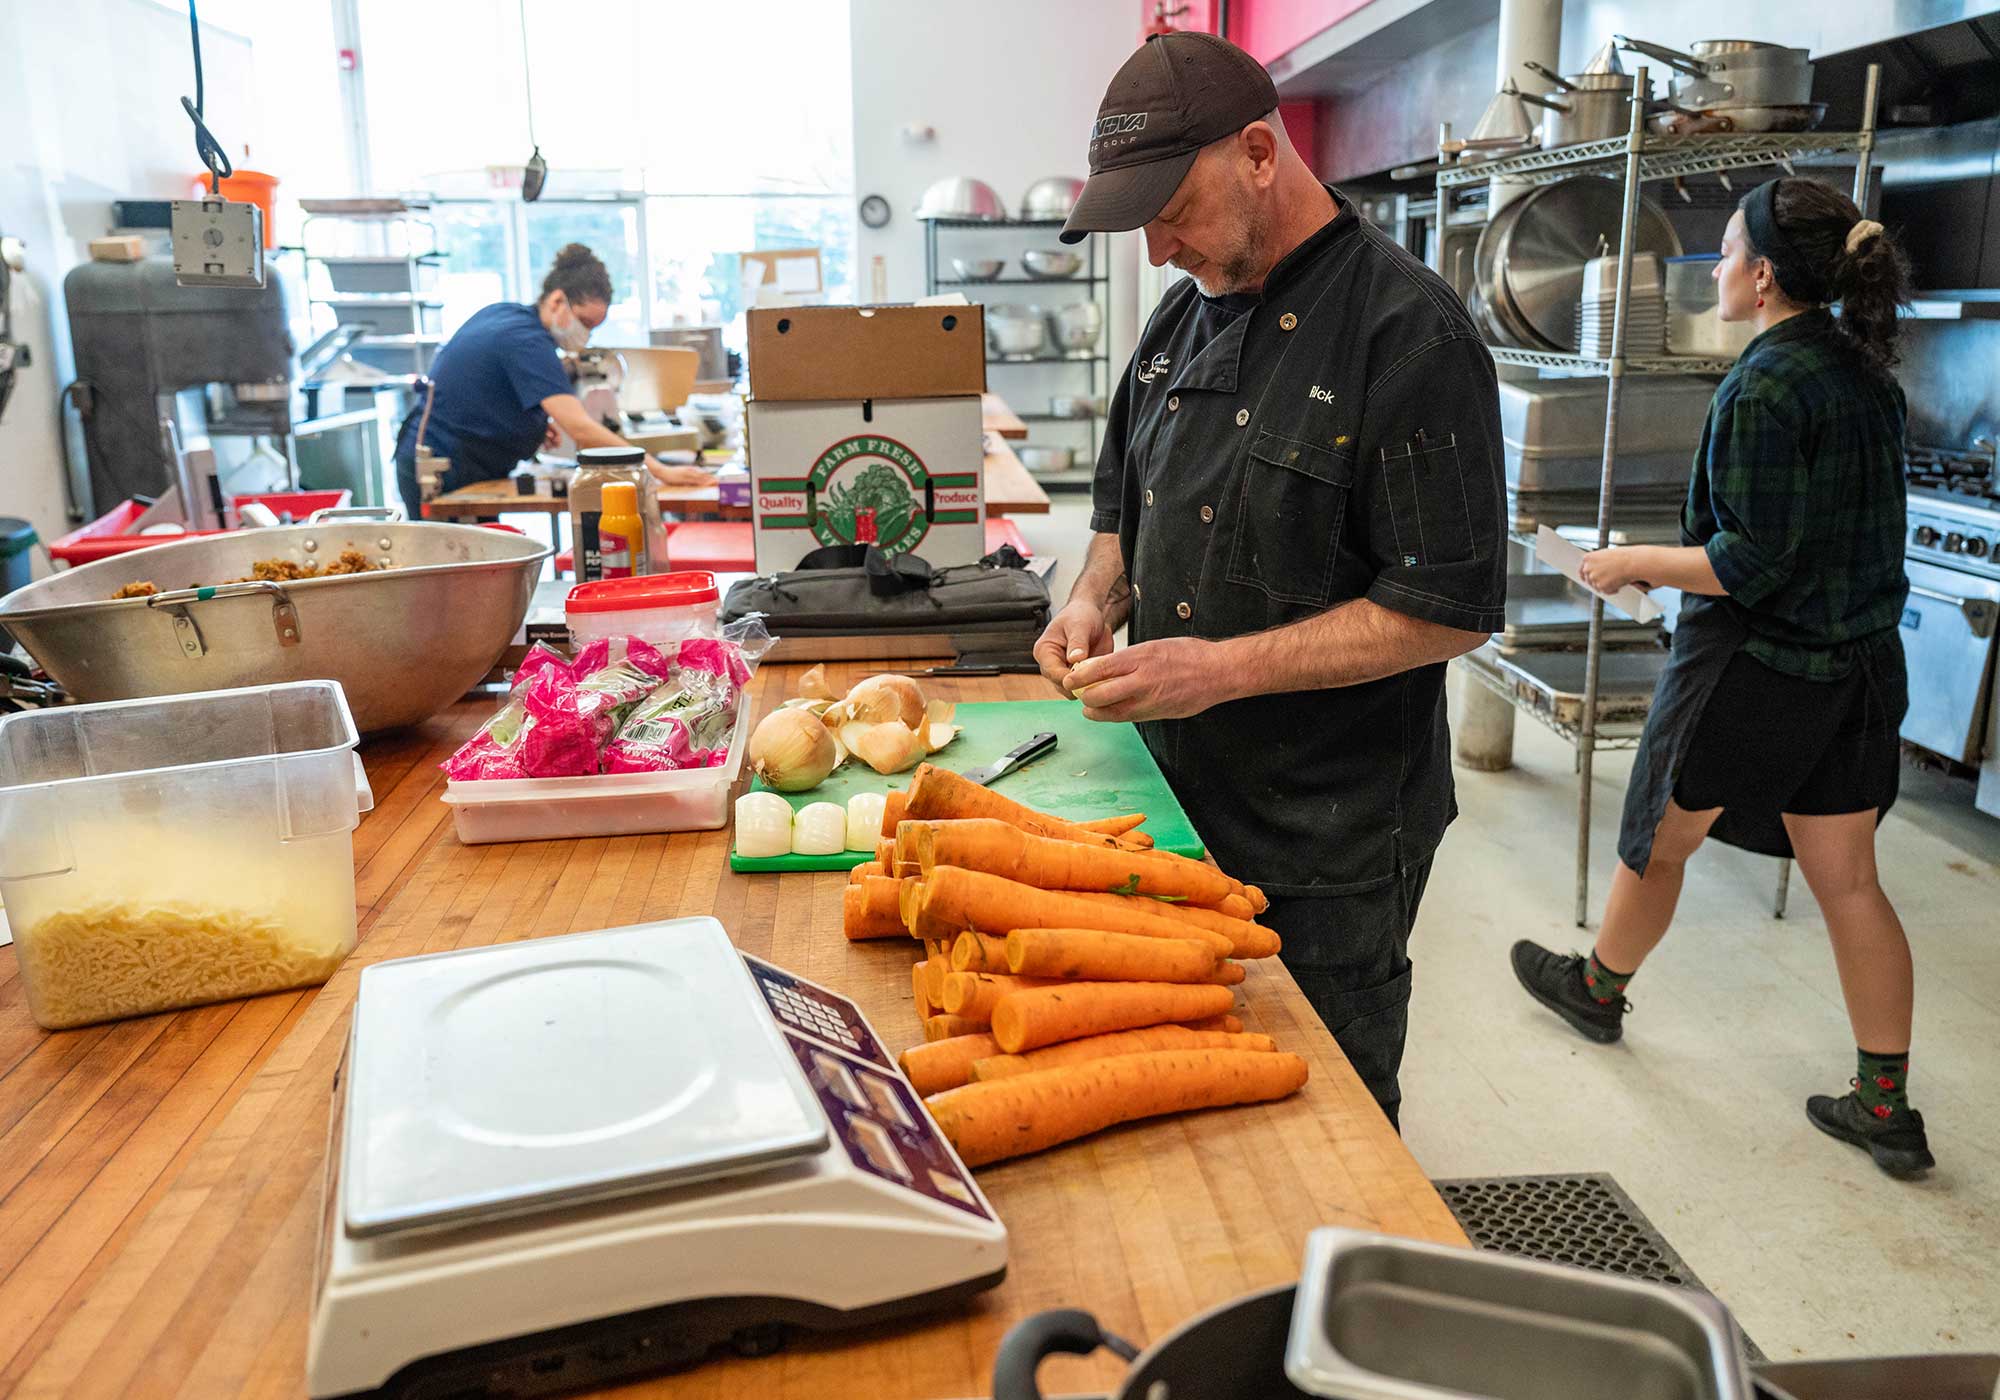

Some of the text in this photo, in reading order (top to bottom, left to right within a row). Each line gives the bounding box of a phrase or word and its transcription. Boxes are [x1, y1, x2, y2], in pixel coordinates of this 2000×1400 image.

[1103, 136, 1137, 148] GOLF
[816, 439, 921, 478] FARM FRESH
[758, 496, 803, 510] Quality
[933, 491, 978, 505] Produce
